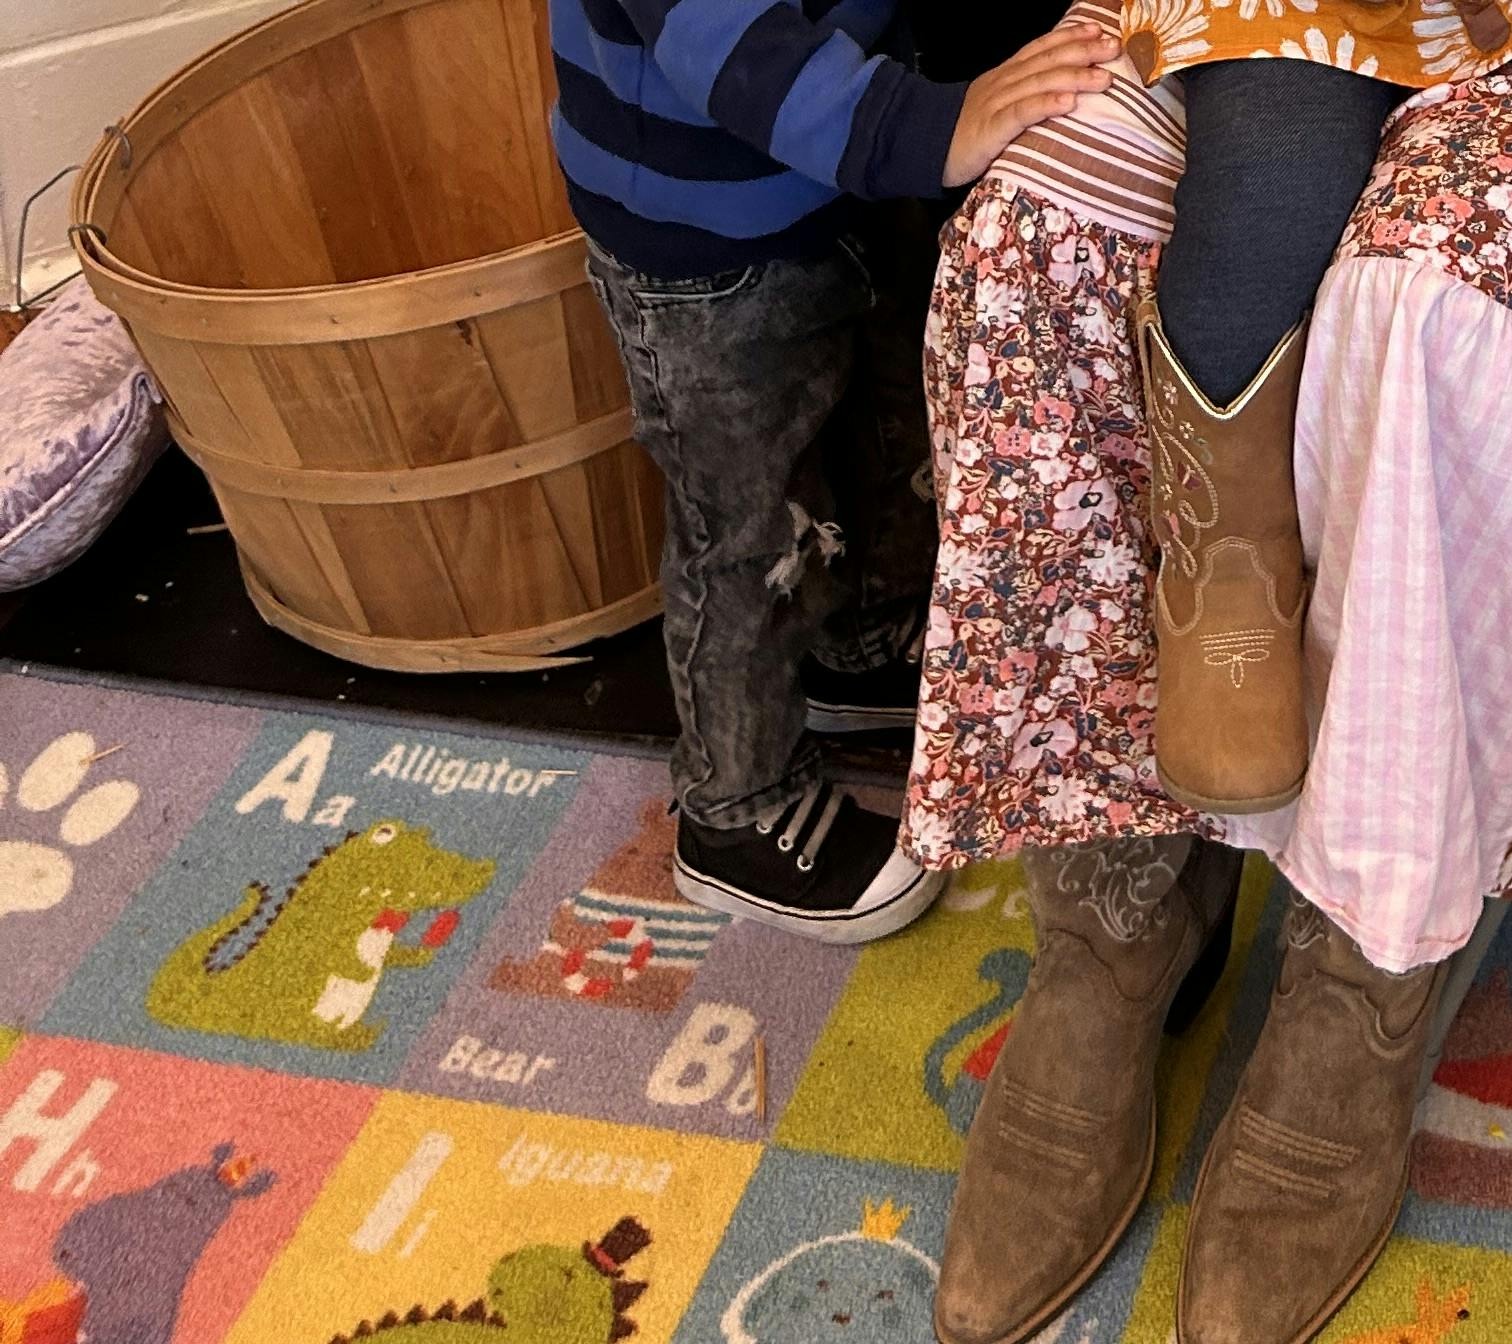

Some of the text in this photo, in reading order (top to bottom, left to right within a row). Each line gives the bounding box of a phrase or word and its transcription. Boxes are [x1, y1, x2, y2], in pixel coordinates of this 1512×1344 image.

[369, 743, 558, 798] Alligator
[439, 1035, 558, 1087] Bear
[499, 1130, 674, 1197] Iguana
